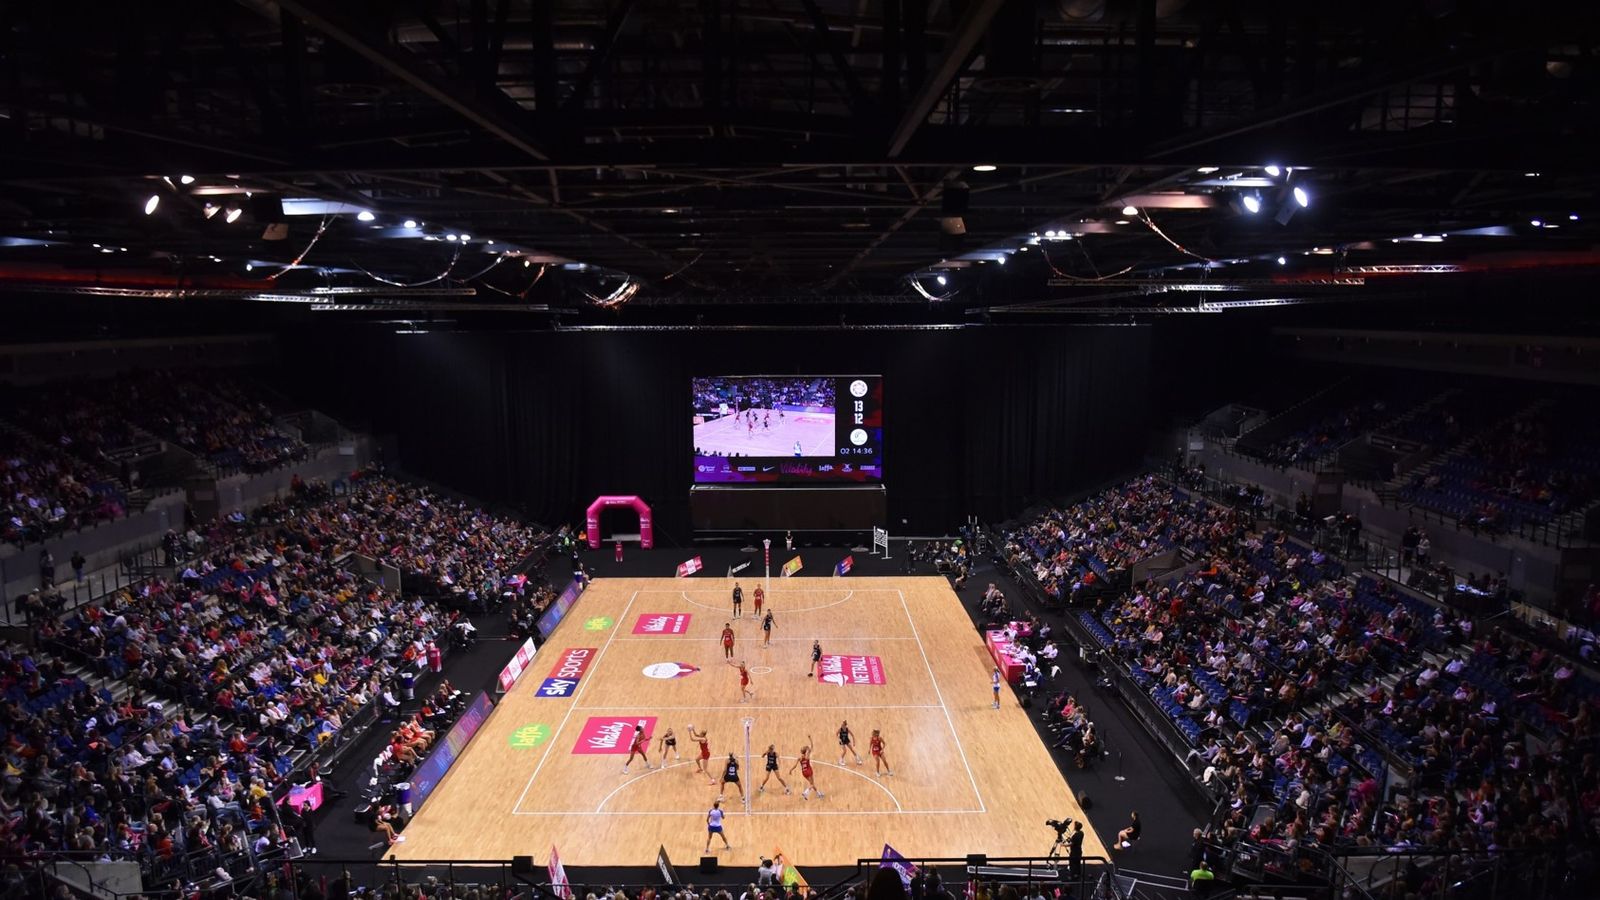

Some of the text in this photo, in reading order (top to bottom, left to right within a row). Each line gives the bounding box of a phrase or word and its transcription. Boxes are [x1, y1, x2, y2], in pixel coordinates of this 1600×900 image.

[854, 400, 864, 412] 13
[854, 413, 863, 425] 12
[557, 649, 590, 678] sports
[850, 656, 870, 684] NETBALL
[542, 679, 576, 695] sky
[587, 721, 633, 749] Vitality
